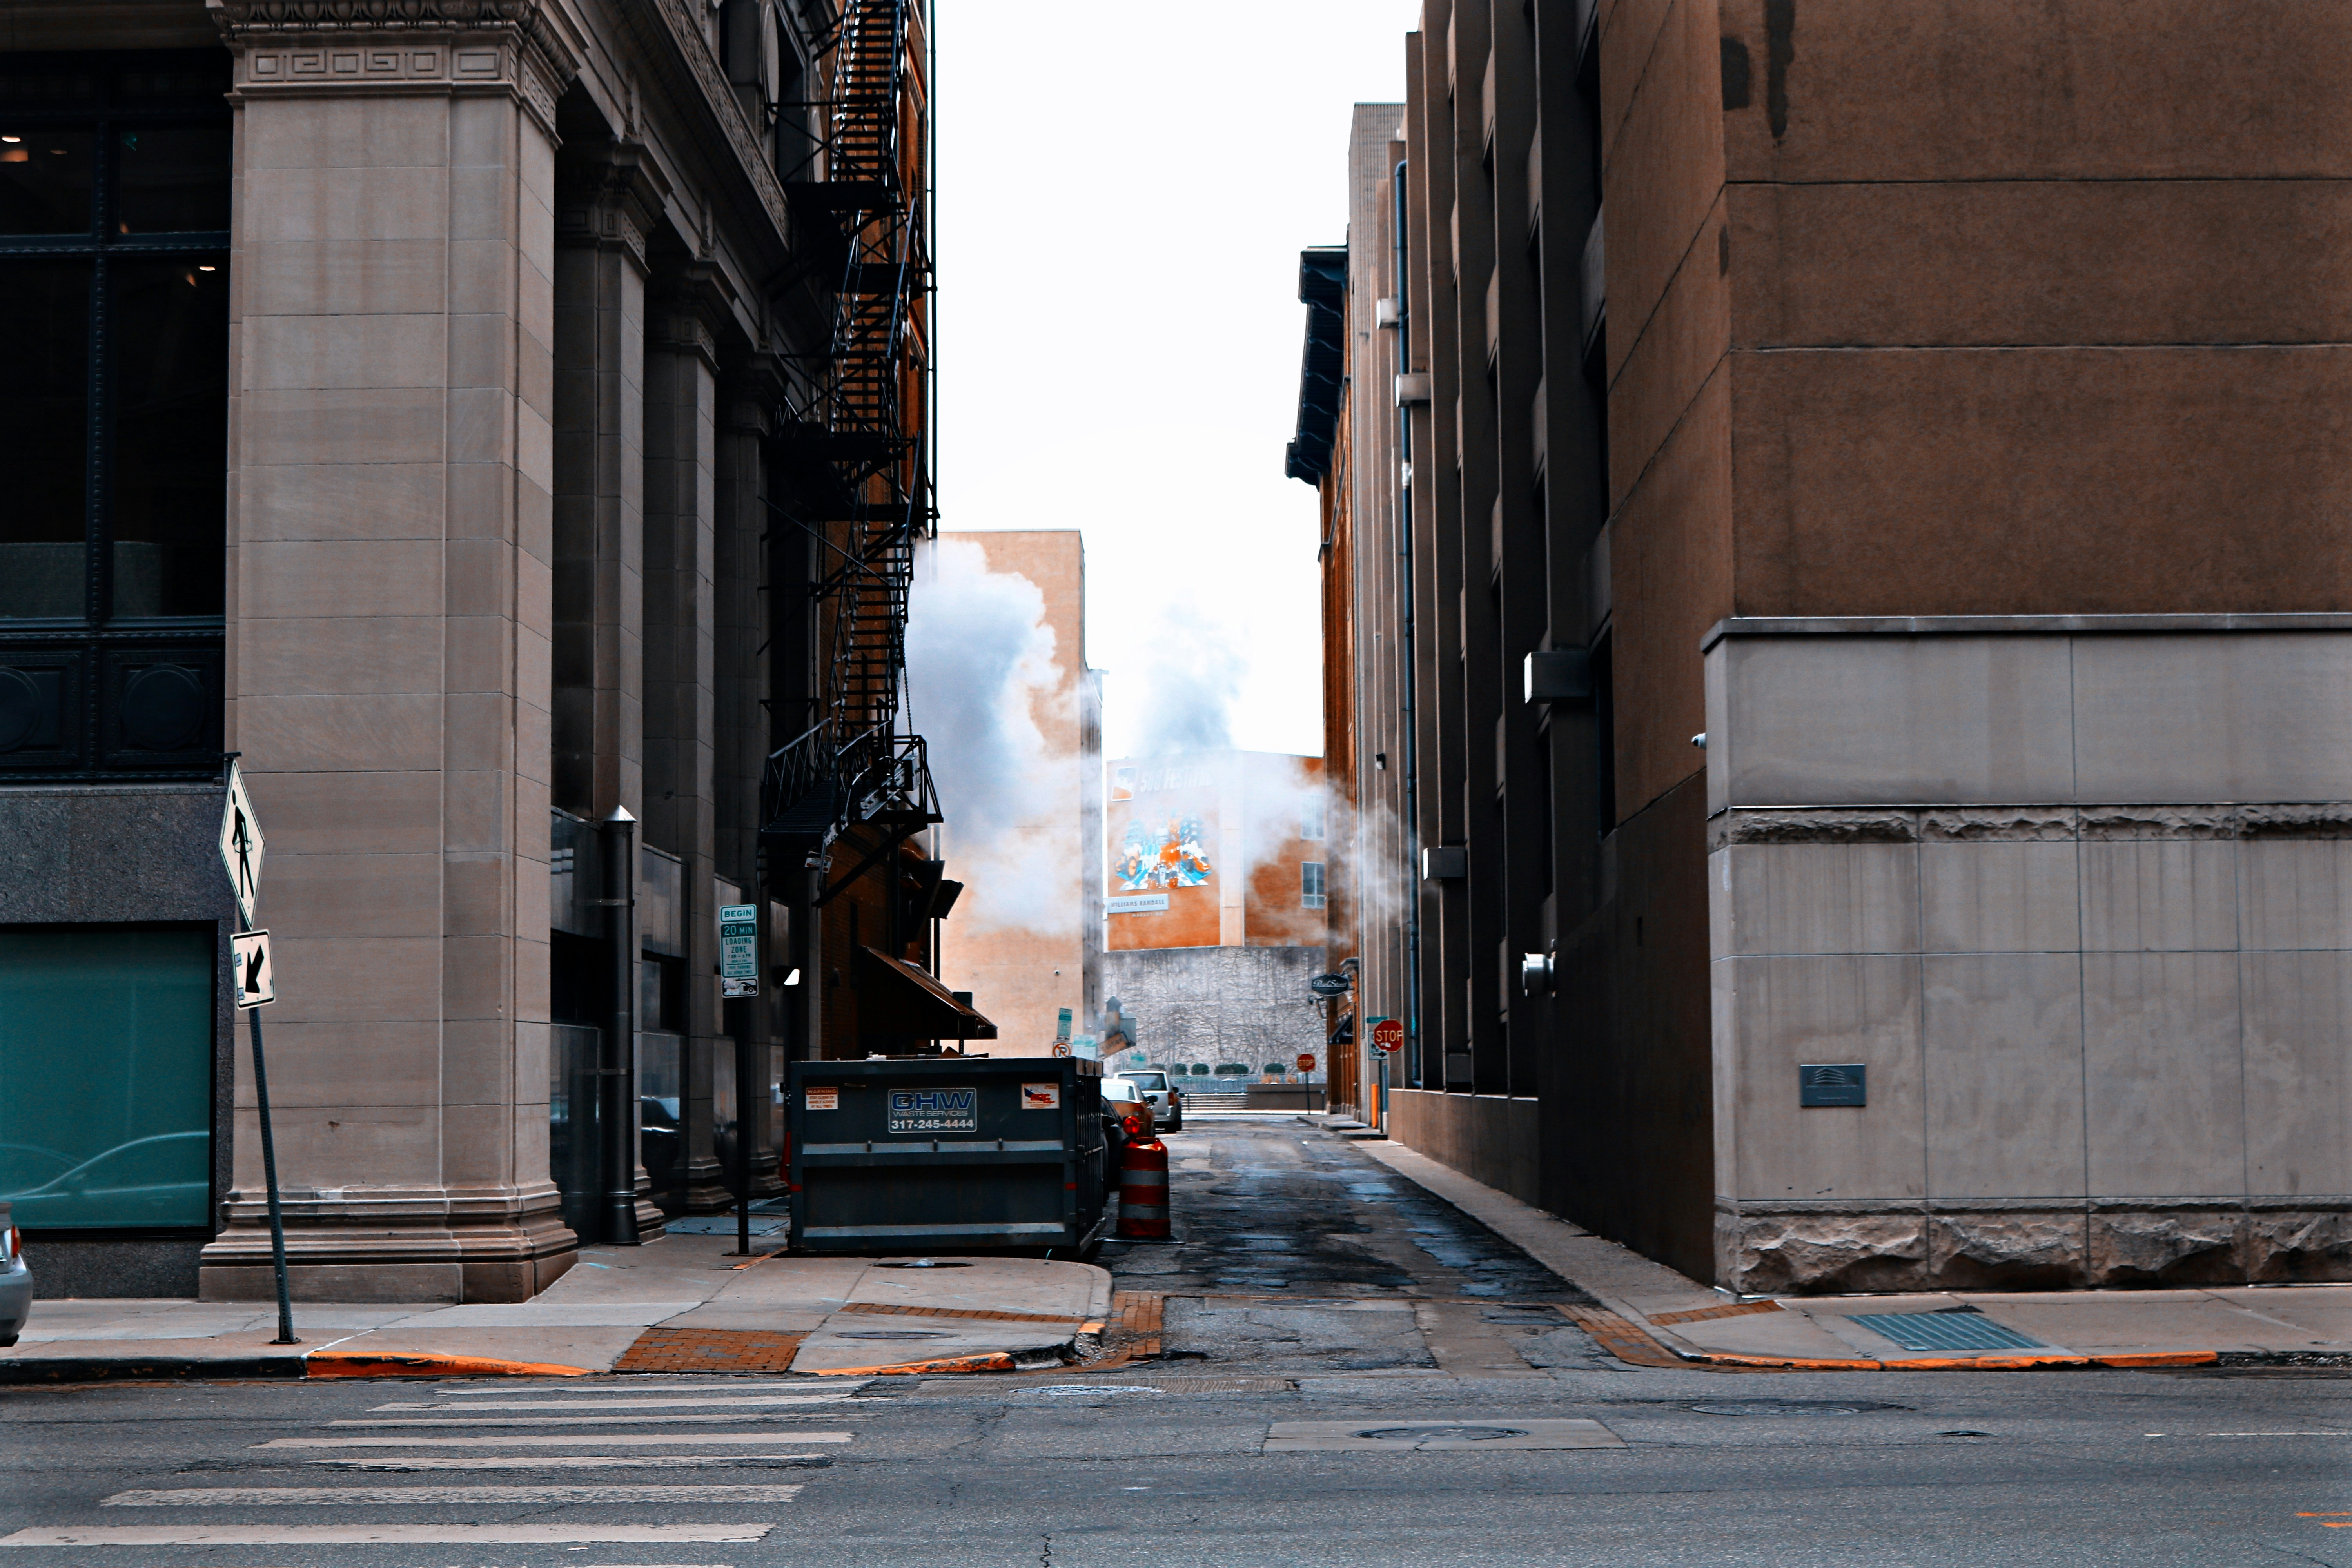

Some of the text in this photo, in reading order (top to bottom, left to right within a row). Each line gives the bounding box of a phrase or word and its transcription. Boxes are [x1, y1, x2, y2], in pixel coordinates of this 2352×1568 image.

[724, 926, 737, 935] 20
[726, 937, 752, 945] LOADING
[1376, 1030, 1403, 1042] STOP
[892, 1092, 973, 1111] GHW
[891, 1119, 974, 1129] 317-245-4444
